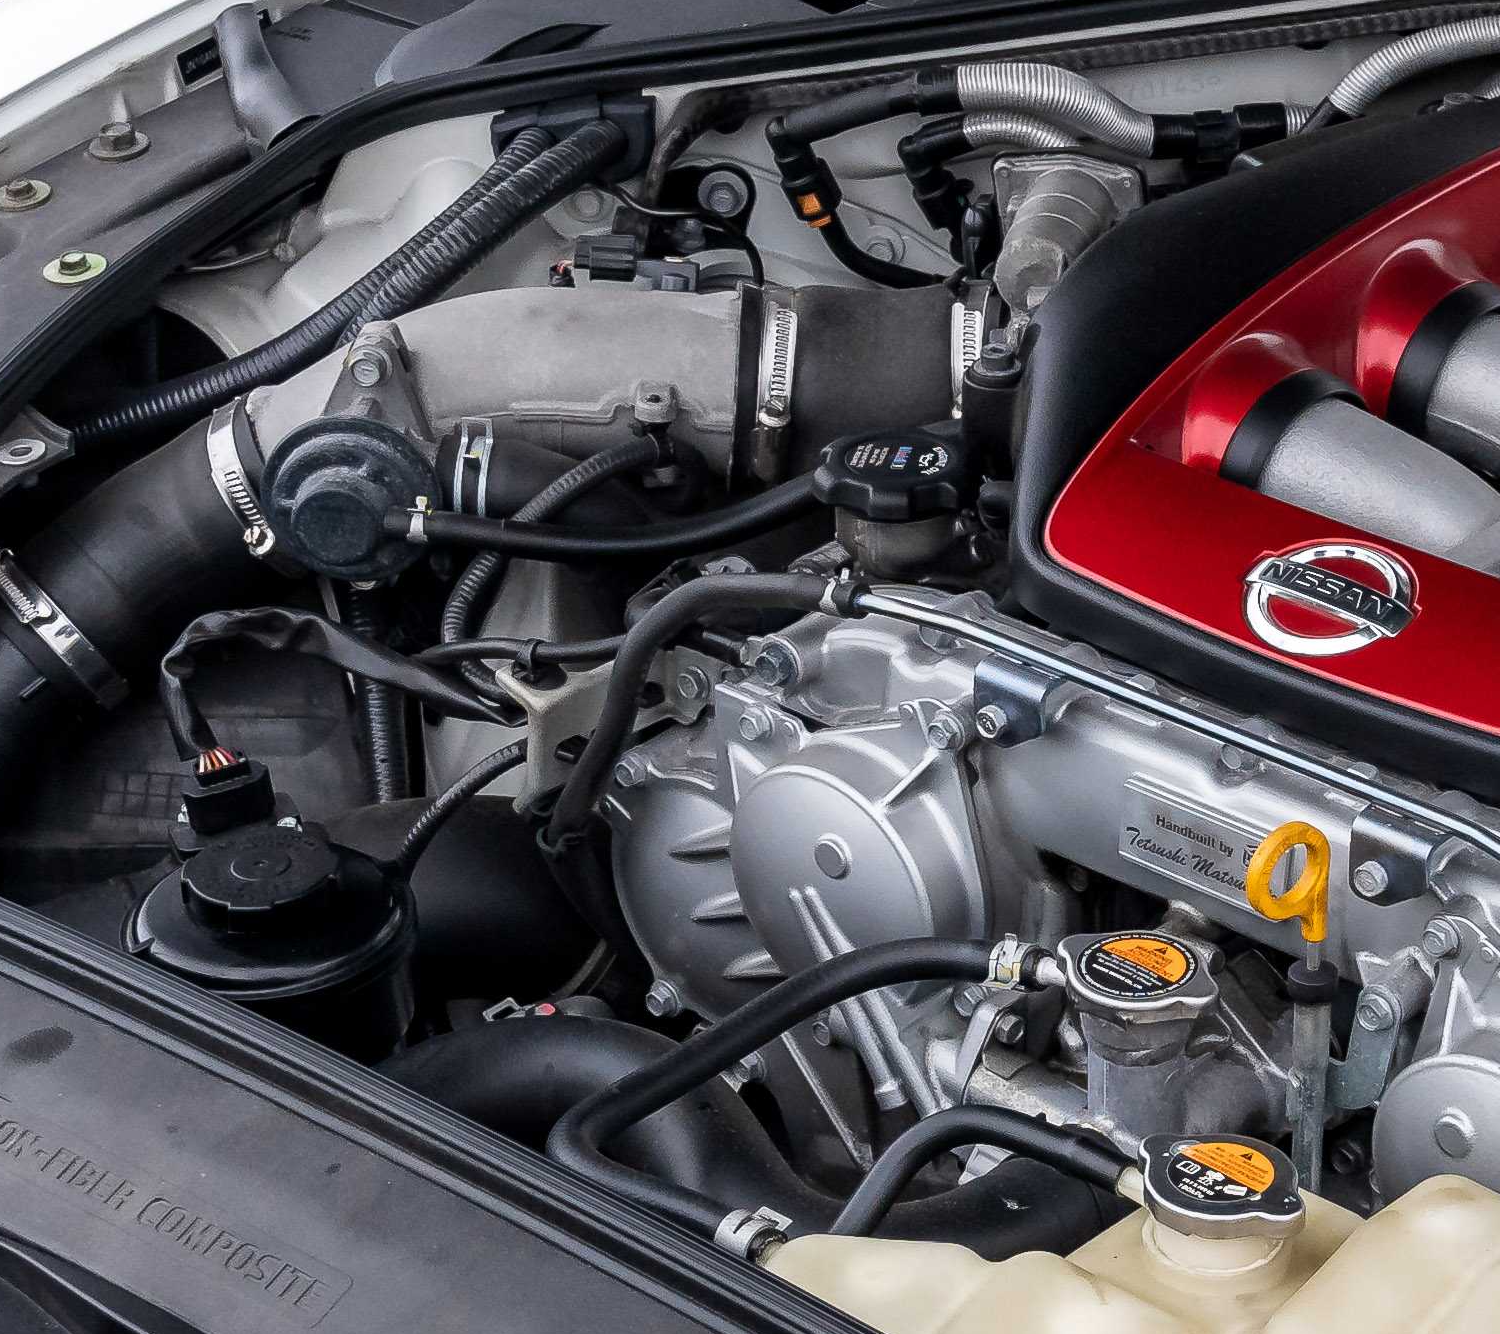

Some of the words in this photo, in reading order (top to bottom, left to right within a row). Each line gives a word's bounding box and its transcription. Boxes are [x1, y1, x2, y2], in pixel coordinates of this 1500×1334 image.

[1261, 560, 1393, 619] NISSAN
[1125, 826, 1188, 866] Tetsushi
[1155, 814, 1216, 849] Handbuilt
[1219, 839, 1235, 858] by
[1136, 945, 1173, 965] WARNING
[135, 1194, 330, 1308] COMPOSITE
